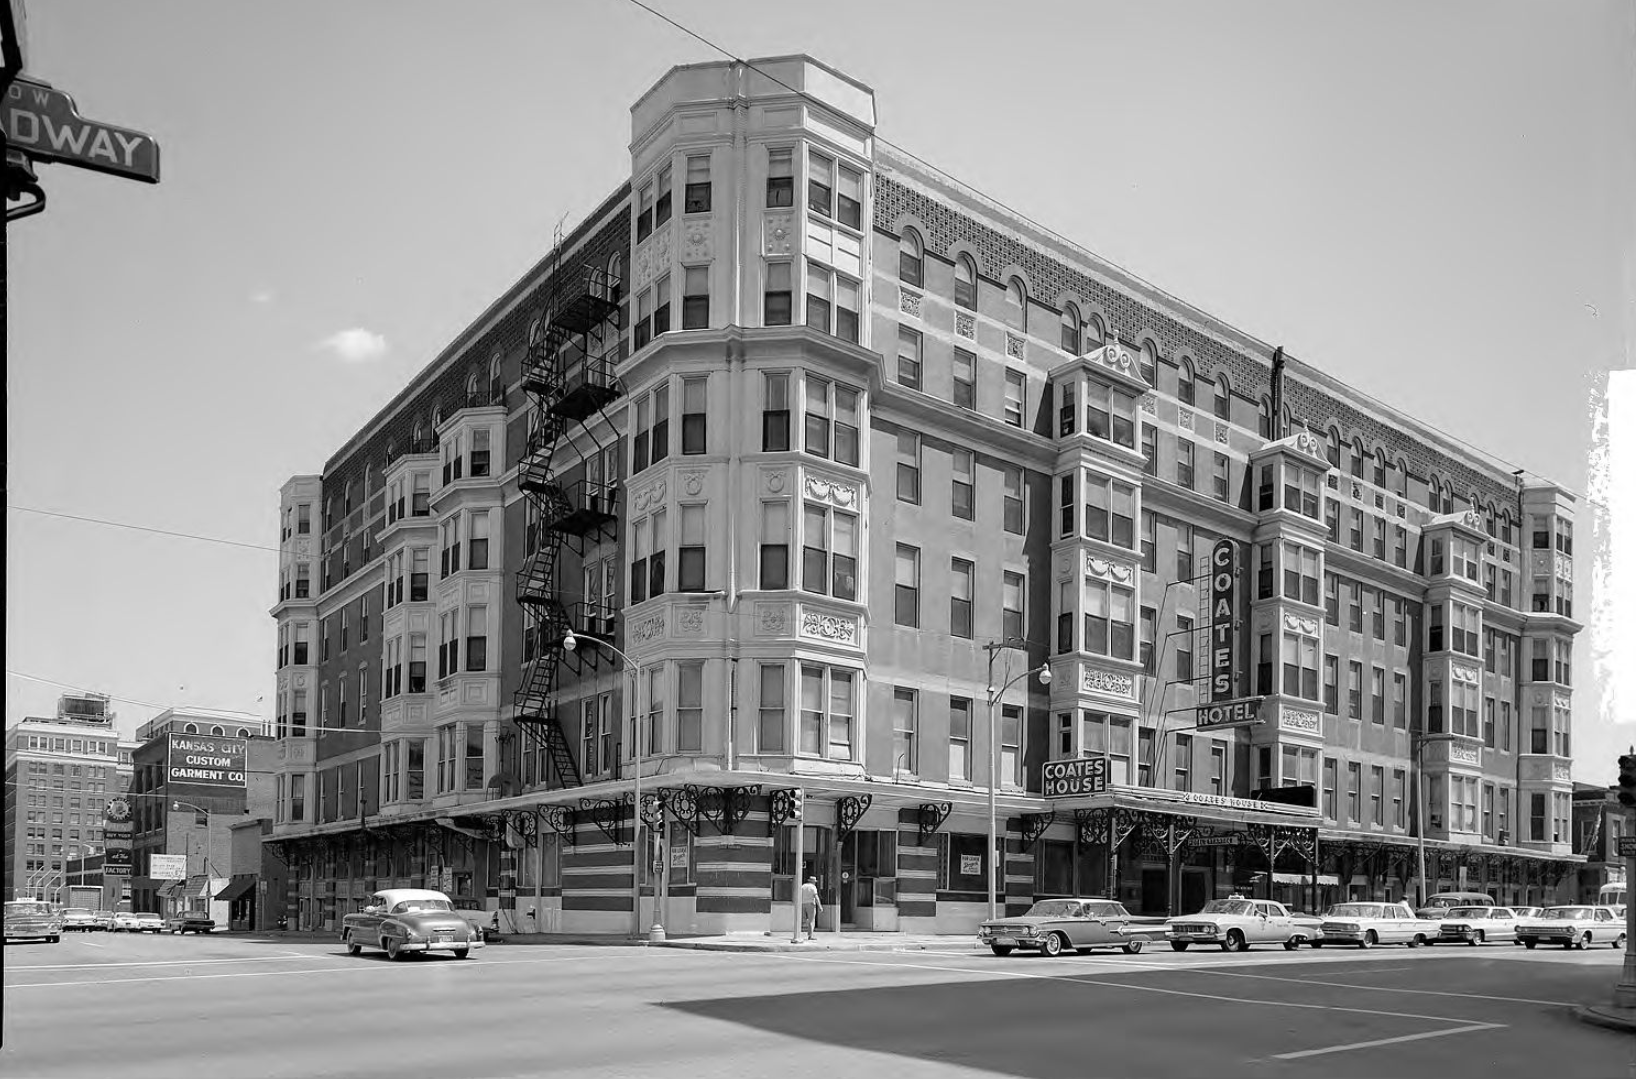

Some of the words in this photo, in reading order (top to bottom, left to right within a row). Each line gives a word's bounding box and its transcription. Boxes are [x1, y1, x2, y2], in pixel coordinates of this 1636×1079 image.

[1213, 546, 1233, 694] COATES
[1197, 704, 1256, 726] HOTEL
[171, 739, 215, 753] KANSAS
[221, 743, 245, 754] CITY
[185, 755, 231, 767] CUSTOM
[170, 767, 225, 780] GARMENT
[227, 771, 246, 782] CO.
[1044, 760, 1104, 780] COATES
[1044, 776, 1103, 795] HOUSE
[105, 866, 131, 874] FACTORY
